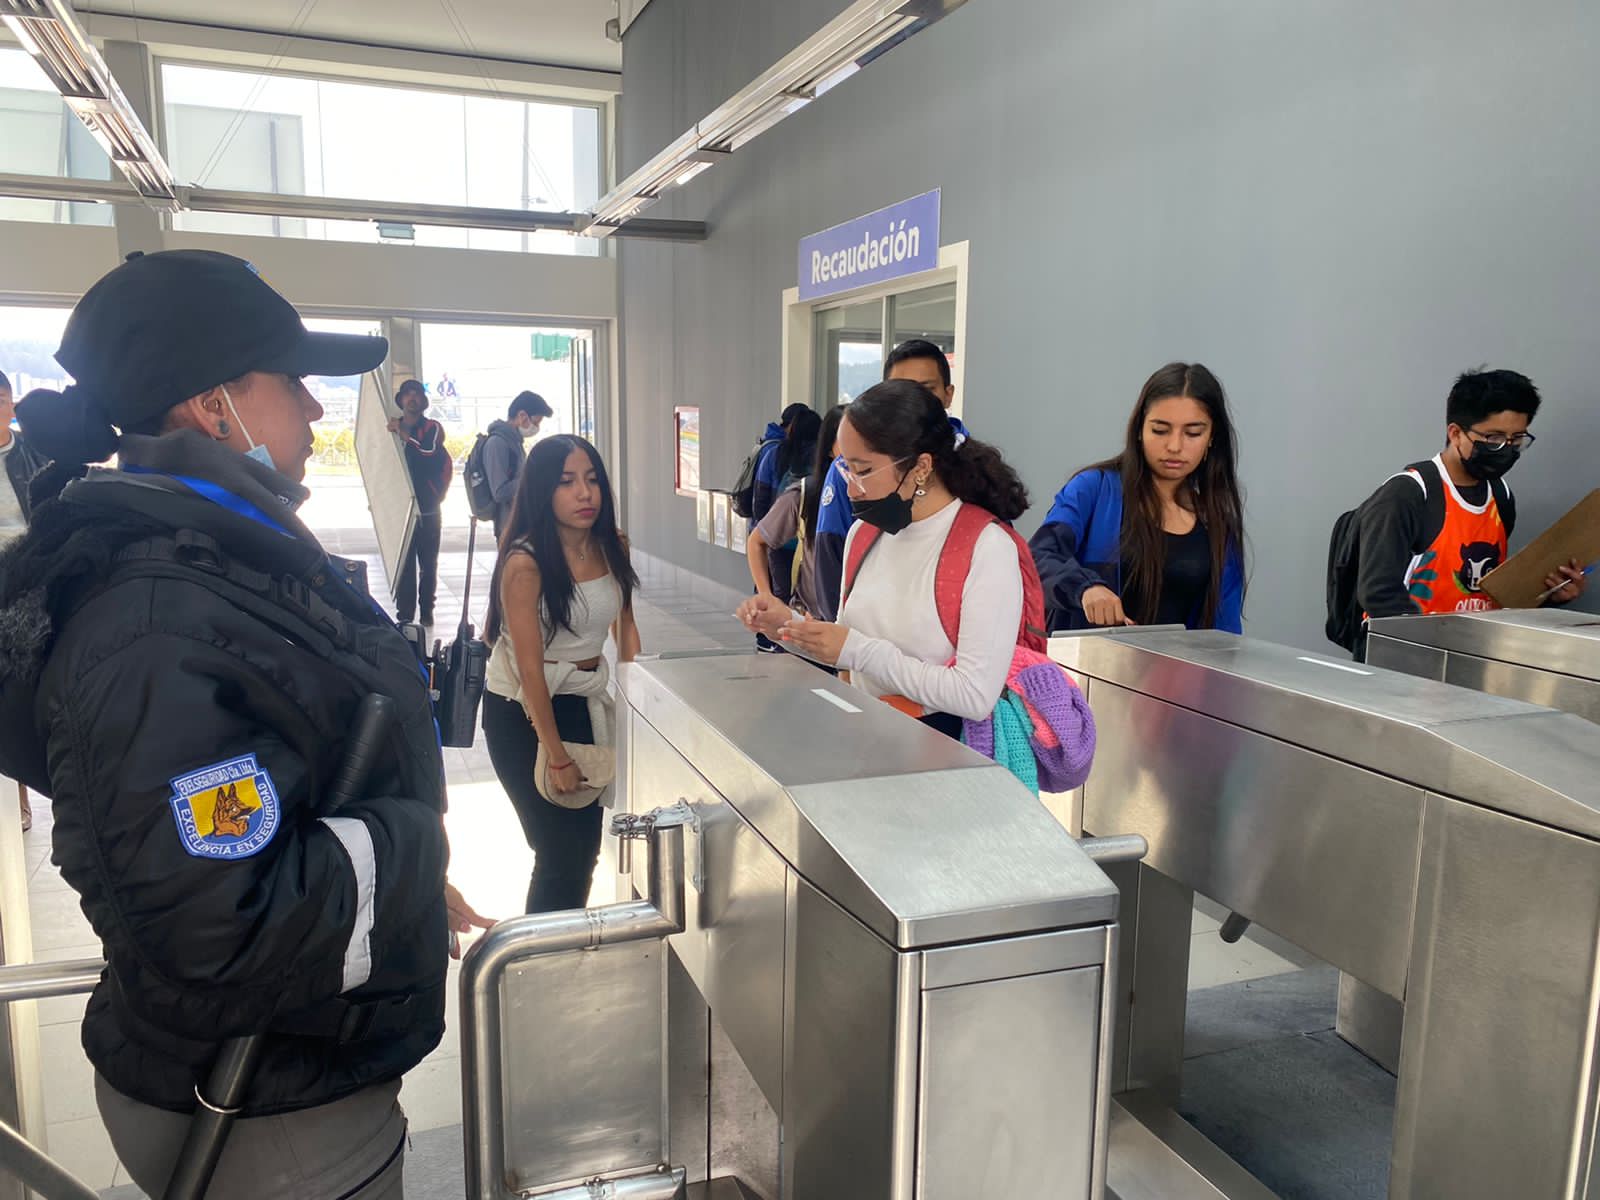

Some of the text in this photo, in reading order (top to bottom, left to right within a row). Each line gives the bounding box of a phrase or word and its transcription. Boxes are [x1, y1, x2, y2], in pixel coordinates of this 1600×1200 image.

[811, 219, 920, 285] Recaudación
[237, 841, 254, 853] EN
[255, 783, 275, 843] SEGURIDAD
